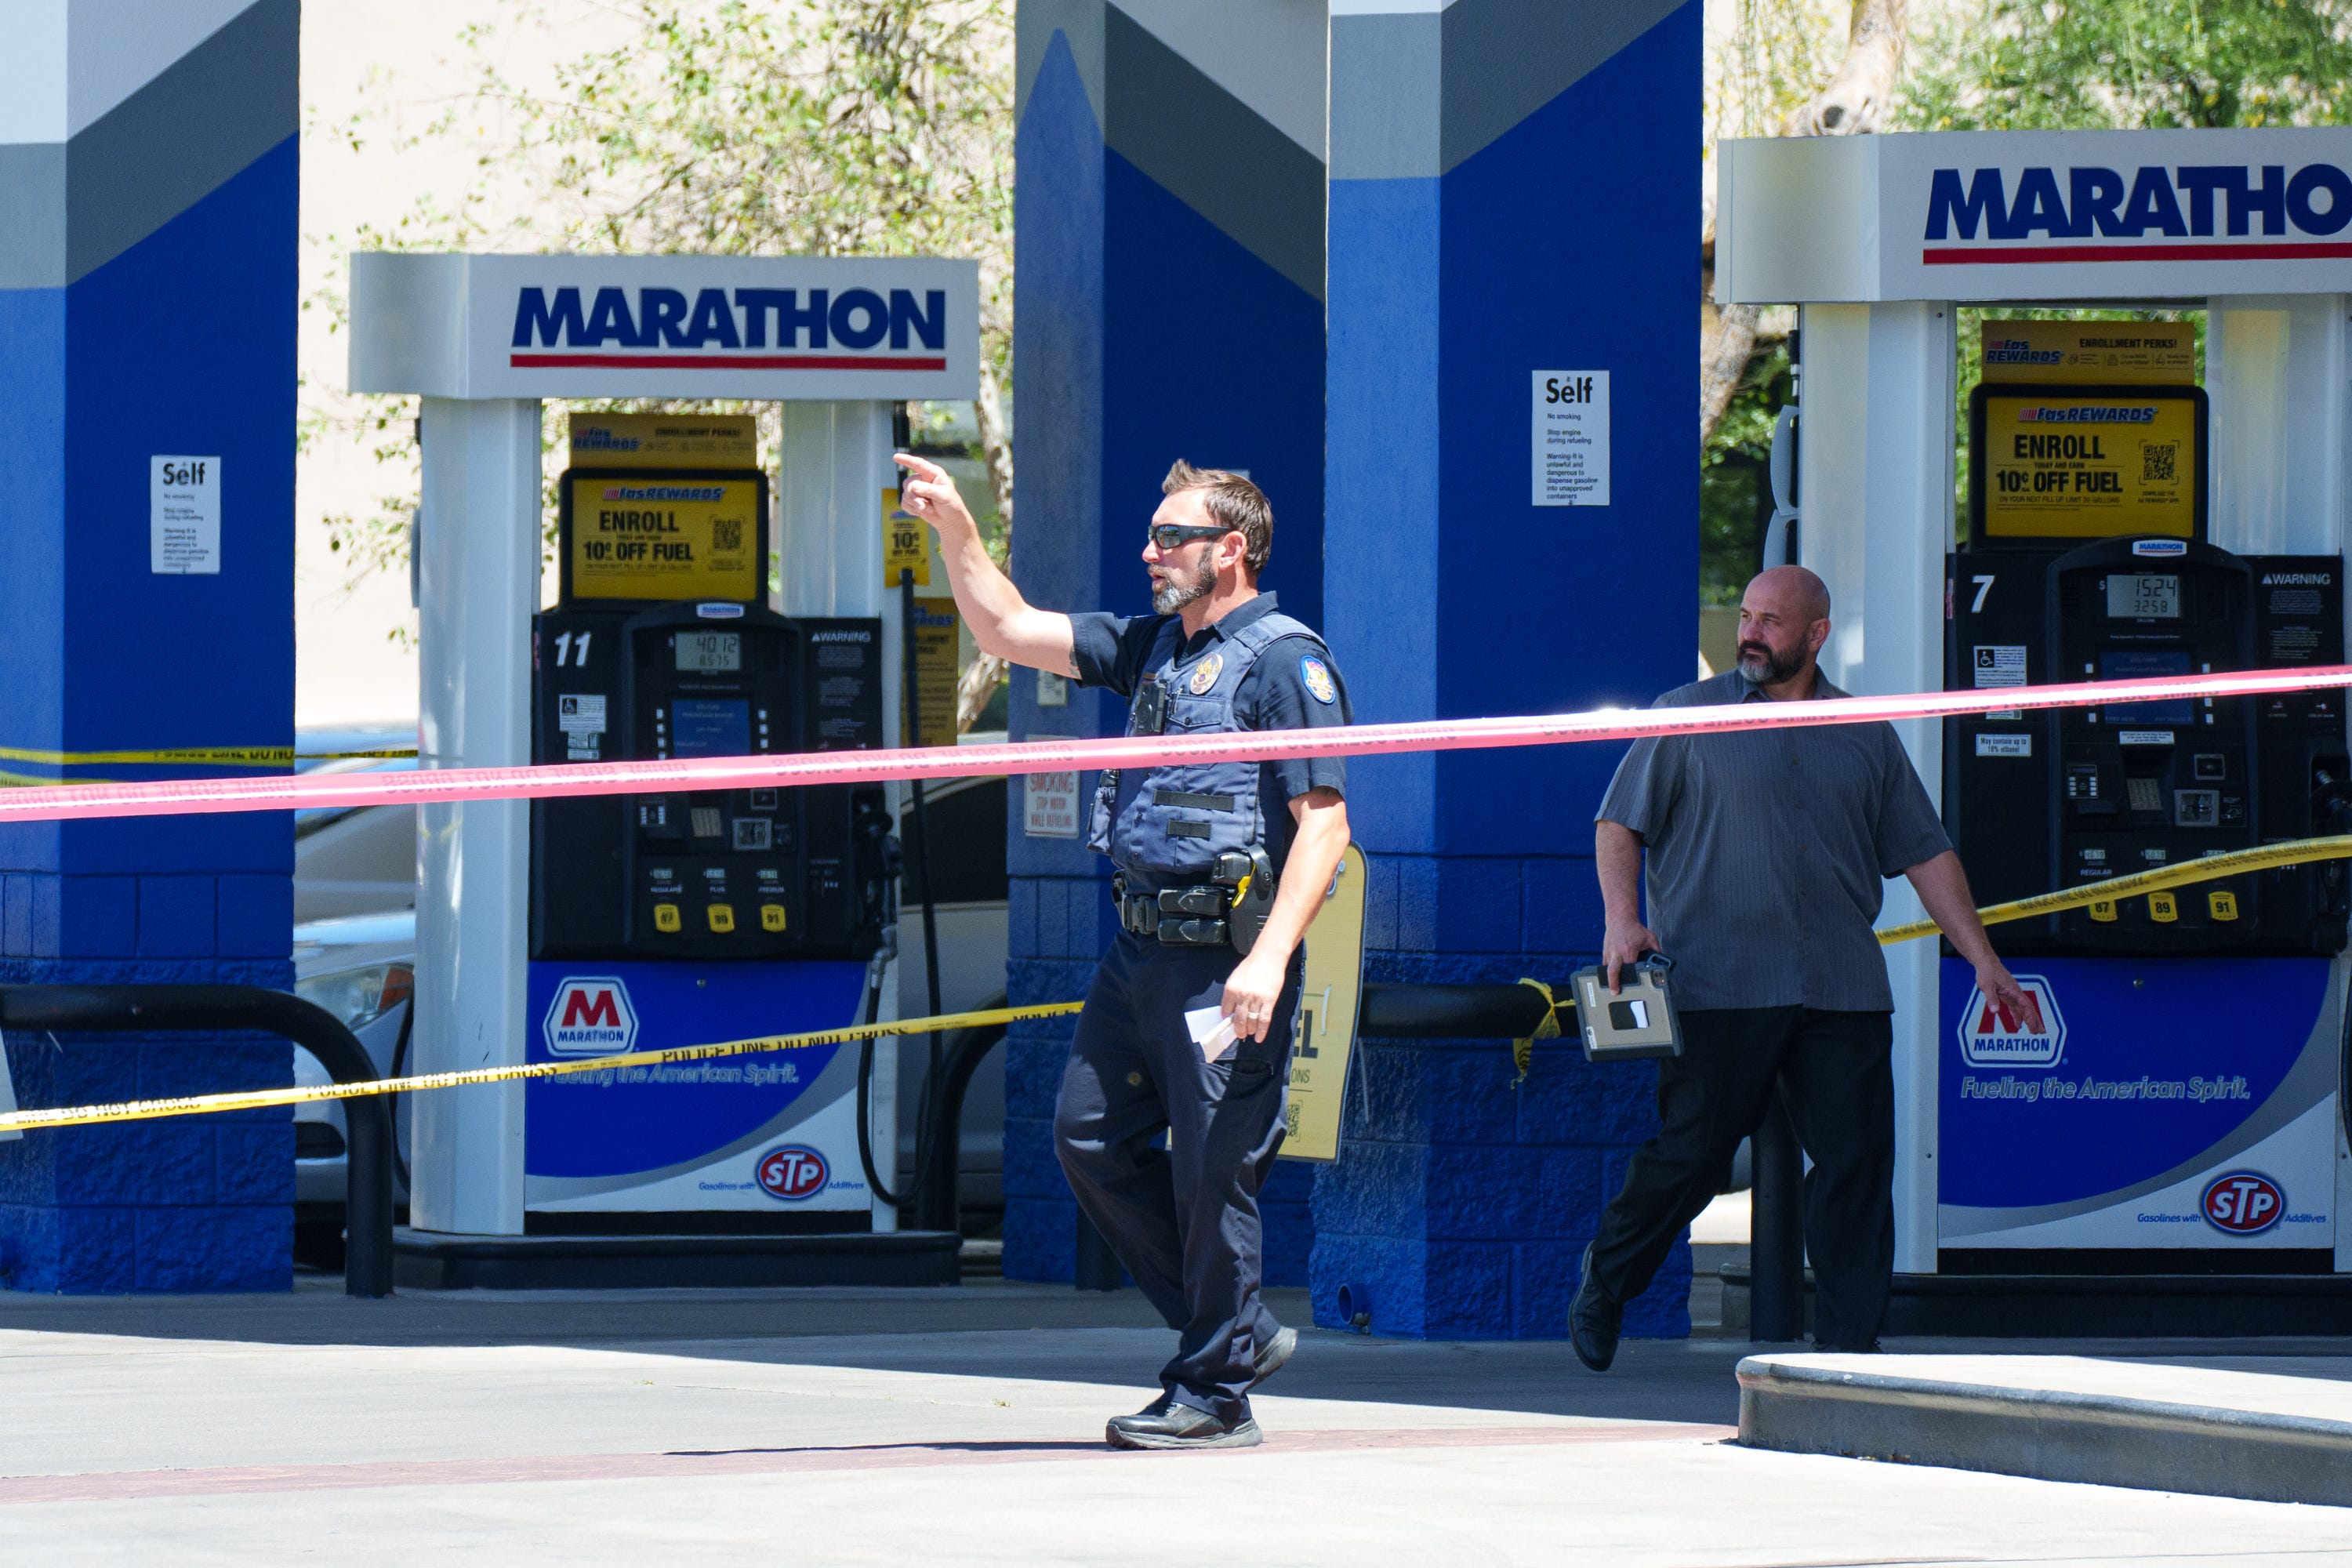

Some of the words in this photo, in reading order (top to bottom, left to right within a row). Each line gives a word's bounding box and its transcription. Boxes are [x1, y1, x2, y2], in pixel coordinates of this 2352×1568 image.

[1924, 163, 2352, 240] MARATHO
[511, 287, 946, 349] MARATHON
[2079, 339, 2141, 347] ENROLLMENT
[2143, 339, 2177, 348] PERKS!
[1986, 350, 2063, 363] REWARDS
[1546, 377, 1592, 404] Self
[2014, 434, 2106, 459] ENROLL
[163, 462, 205, 485] Self
[2034, 471, 2070, 492] OFF
[2075, 472, 2124, 493] FUEL
[599, 510, 680, 532] ENROLL
[616, 542, 647, 561] OFF
[652, 543, 694, 561] FUEL
[2271, 573, 2332, 585] WARNING
[1971, 575, 1995, 613] 7
[820, 630, 871, 642] WARNING
[554, 630, 592, 667] 11
[1029, 772, 1074, 793] SMOKING
[2095, 902, 2109, 913] 87
[2155, 902, 2171, 913] 89
[2216, 902, 2230, 913] 91
[562, 990, 621, 1026] M
[557, 1030, 624, 1043] MARATHON
[1973, 1037, 2049, 1052] MARATHON
[616, 1063, 647, 1083] the
[649, 1063, 741, 1083] American
[742, 1063, 799, 1086] Spirit.
[1962, 1076, 2039, 1102] Fueling
[2042, 1076, 2076, 1098] the
[2078, 1076, 2184, 1098] American
[2187, 1076, 2250, 1103] Spirit.
[766, 1153, 821, 1192] STP
[699, 1182, 737, 1191] Gasolines
[829, 1181, 864, 1190] Additives
[2212, 1181, 2274, 1225] STP
[2137, 1213, 2180, 1224] Gasolines
[2182, 1213, 2201, 1224] with
[2285, 1213, 2326, 1224] Additives
